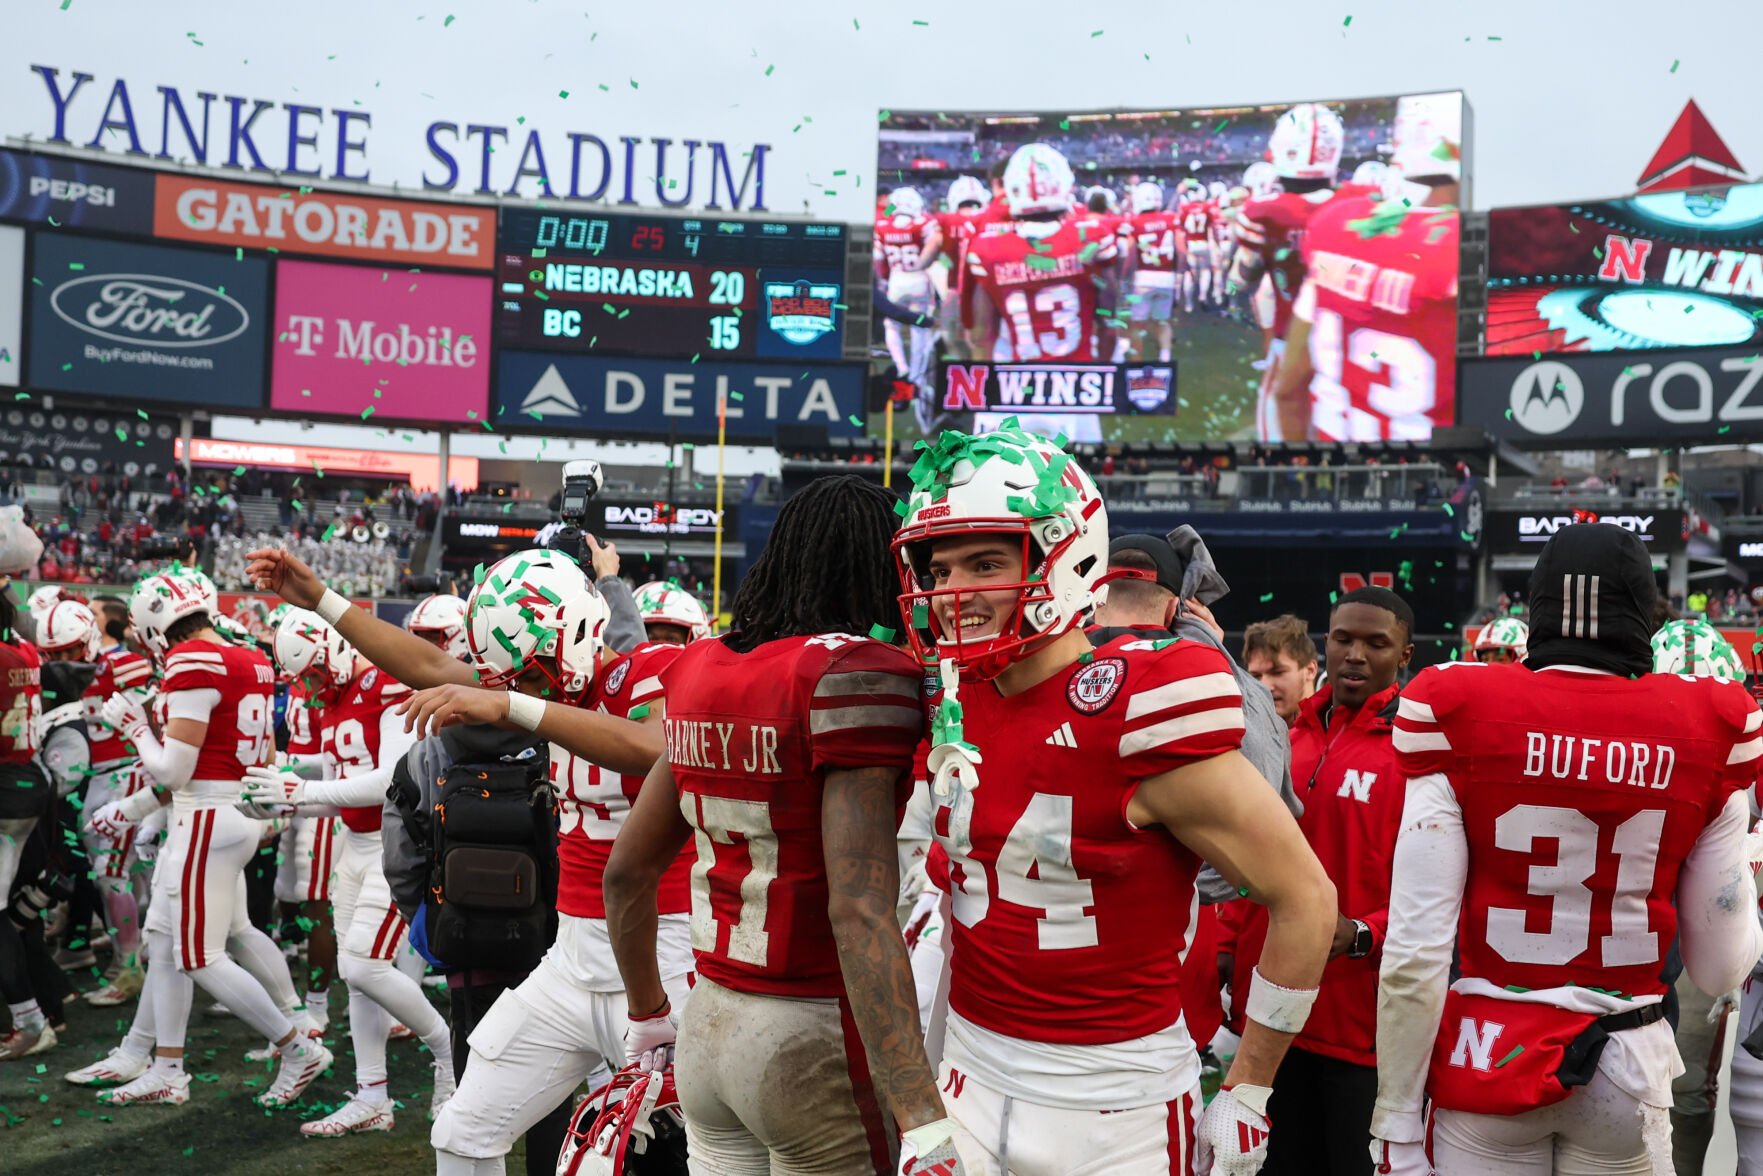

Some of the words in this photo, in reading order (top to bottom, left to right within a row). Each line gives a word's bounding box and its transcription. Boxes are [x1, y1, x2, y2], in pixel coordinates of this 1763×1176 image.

[30, 64, 371, 181] YANKEE
[422, 121, 771, 212] STADIUM
[30, 176, 115, 207] PEPSI
[176, 188, 480, 256] GATORADE
[537, 216, 609, 250] 0:00
[631, 226, 665, 249] 25
[684, 235, 700, 257] 4
[1601, 235, 1653, 283] N
[545, 263, 694, 298] NEBRASKA
[709, 271, 744, 305] 20
[86, 281, 216, 338] Ford
[543, 308, 582, 337] BC
[1006, 284, 1083, 362] 13
[336, 319, 477, 367] Mobile
[709, 316, 740, 350] 15
[84, 345, 213, 370] BuyFordNow.com
[605, 370, 841, 421] DELTA
[944, 364, 990, 411] N
[1000, 371, 1114, 407] WINS!
[198, 442, 295, 463] MOWERS
[605, 506, 653, 523] BAD
[676, 508, 724, 525] BOY
[918, 505, 951, 521] HUSKERS
[460, 524, 499, 537] MOW
[1075, 659, 1109, 679] NEBRASKA
[1080, 677, 1112, 686] HUSKERS
[1091, 683, 1119, 711] TRADITION
[666, 719, 734, 769] BARNEY
[743, 725, 783, 774] JR
[1523, 731, 1676, 790] BUFORD
[1337, 769, 1377, 803] N
[679, 791, 779, 967] 17
[930, 778, 1099, 950] 84
[1486, 804, 1666, 967] 31
[1449, 1017, 1505, 1073] N
[943, 1068, 967, 1098] N
